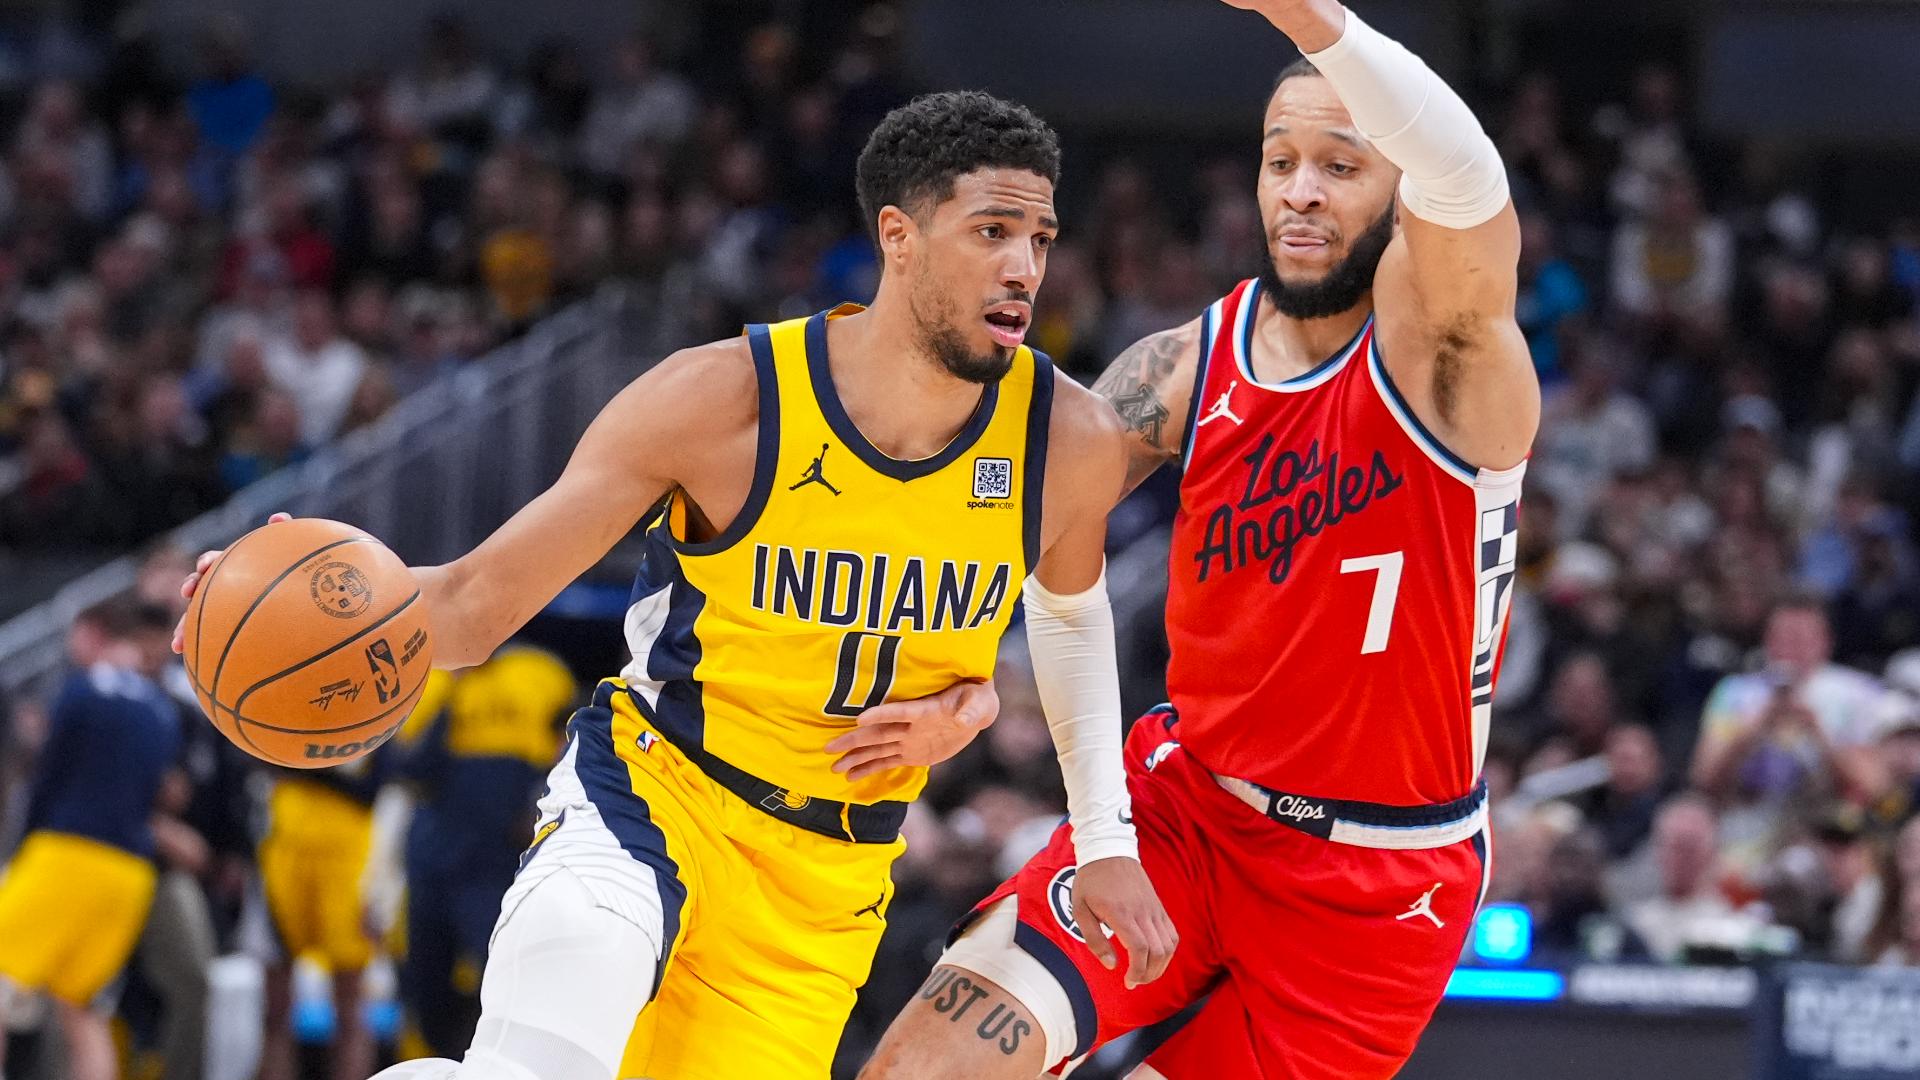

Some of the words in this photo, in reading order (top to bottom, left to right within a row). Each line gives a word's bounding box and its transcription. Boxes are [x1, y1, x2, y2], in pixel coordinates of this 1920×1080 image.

[967, 499, 1014, 510] spokenote
[1237, 432, 1325, 512] Los
[1194, 450, 1403, 584] Angeles
[750, 543, 1011, 633] INDIANA
[1340, 551, 1404, 655] 7
[823, 631, 903, 718] 0
[1276, 795, 1326, 822] Clips
[976, 1003, 1031, 1055] US
